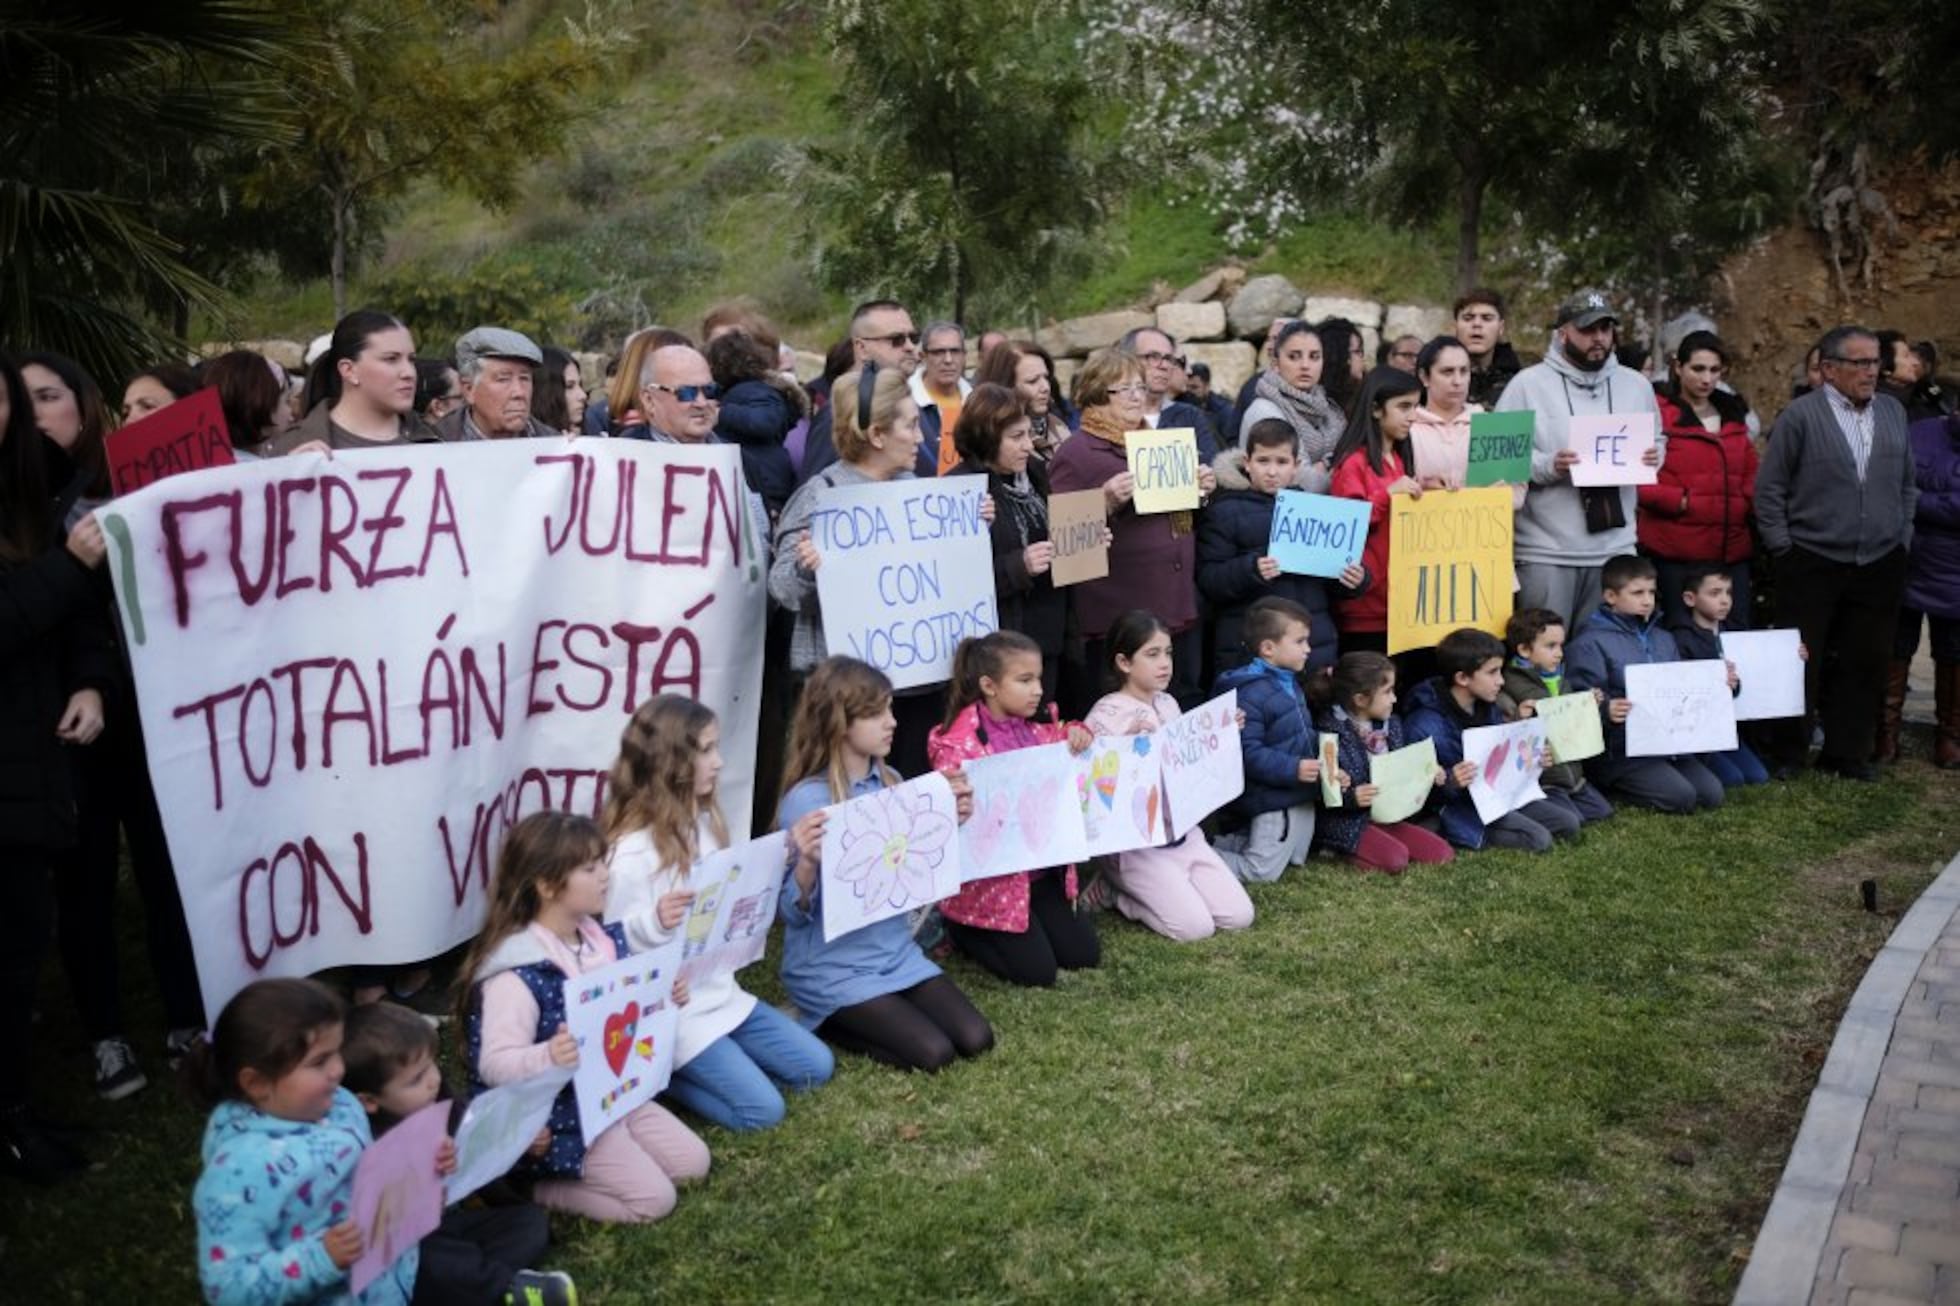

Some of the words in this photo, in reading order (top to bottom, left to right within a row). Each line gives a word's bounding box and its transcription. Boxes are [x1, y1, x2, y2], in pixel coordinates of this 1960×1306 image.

[117, 412, 235, 494] EMPATÍA
[1136, 440, 1195, 490] CARIÑO
[1595, 425, 1627, 466] FÉ
[808, 506, 895, 550] TODA
[1441, 505, 1509, 552] SOMOS
[879, 560, 942, 606] CON
[173, 613, 506, 811] TOTALÁN
[527, 594, 716, 719] ESTÁ
[240, 831, 372, 971] CON
